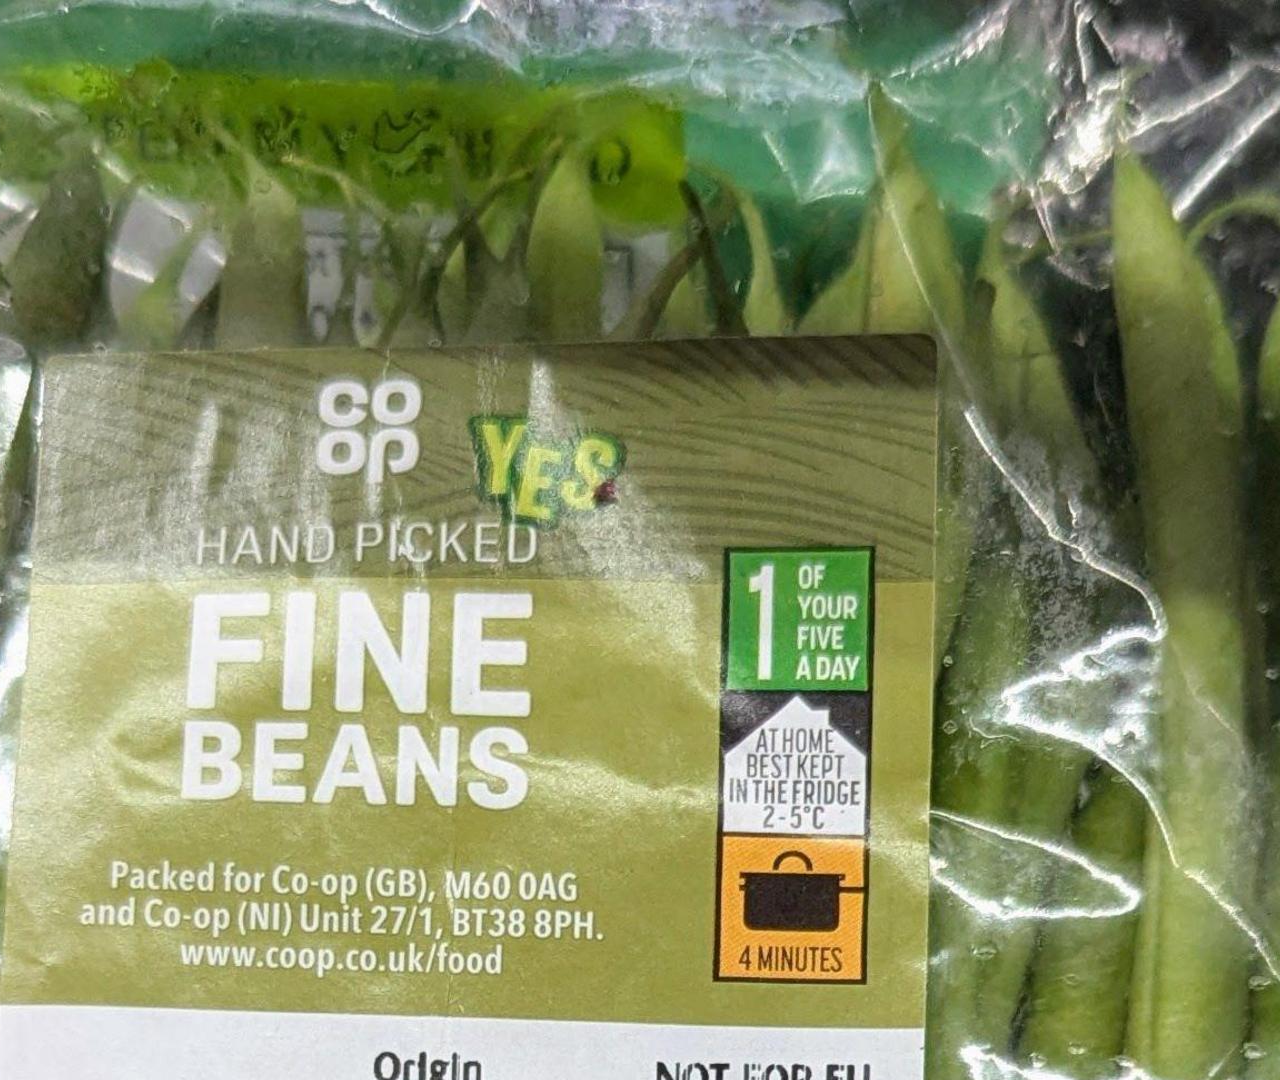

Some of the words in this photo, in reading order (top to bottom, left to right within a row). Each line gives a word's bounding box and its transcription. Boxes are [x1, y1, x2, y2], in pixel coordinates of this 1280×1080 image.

[481, 418, 618, 521] YES
[196, 523, 334, 564] HAND
[356, 522, 537, 564] PICKED
[798, 565, 825, 589] OF
[749, 565, 775, 680] 1
[797, 596, 857, 619] YOUR
[797, 625, 844, 649] FIVE
[186, 592, 533, 716] FINE
[796, 657, 811, 680] A
[817, 656, 859, 681] DAY
[756, 729, 778, 753] AT
[783, 729, 834, 753] HOME
[181, 720, 529, 810] BEANS
[748, 754, 793, 779] BEST
[798, 754, 845, 780] KEPT
[730, 779, 748, 803] IN
[753, 779, 787, 804] THE
[792, 780, 860, 805] FRIDGE
[111, 861, 215, 893] Packed
[223, 863, 264, 893] for
[272, 865, 358, 903] Co-op
[365, 868, 435, 902] (GB),
[446, 871, 510, 900] M60
[519, 871, 577, 901] 0AG
[81, 899, 133, 926] and
[144, 900, 230, 936] Co-op
[238, 902, 292, 936] (NI)
[301, 904, 362, 934] Unit
[371, 906, 443, 940] 27/1,
[453, 909, 525, 937] BT38
[535, 911, 604, 940] 8PH.
[181, 941, 503, 977] www.coop.co.uk/food
[739, 945, 752, 971] 4
[758, 946, 842, 973] MINUTES
